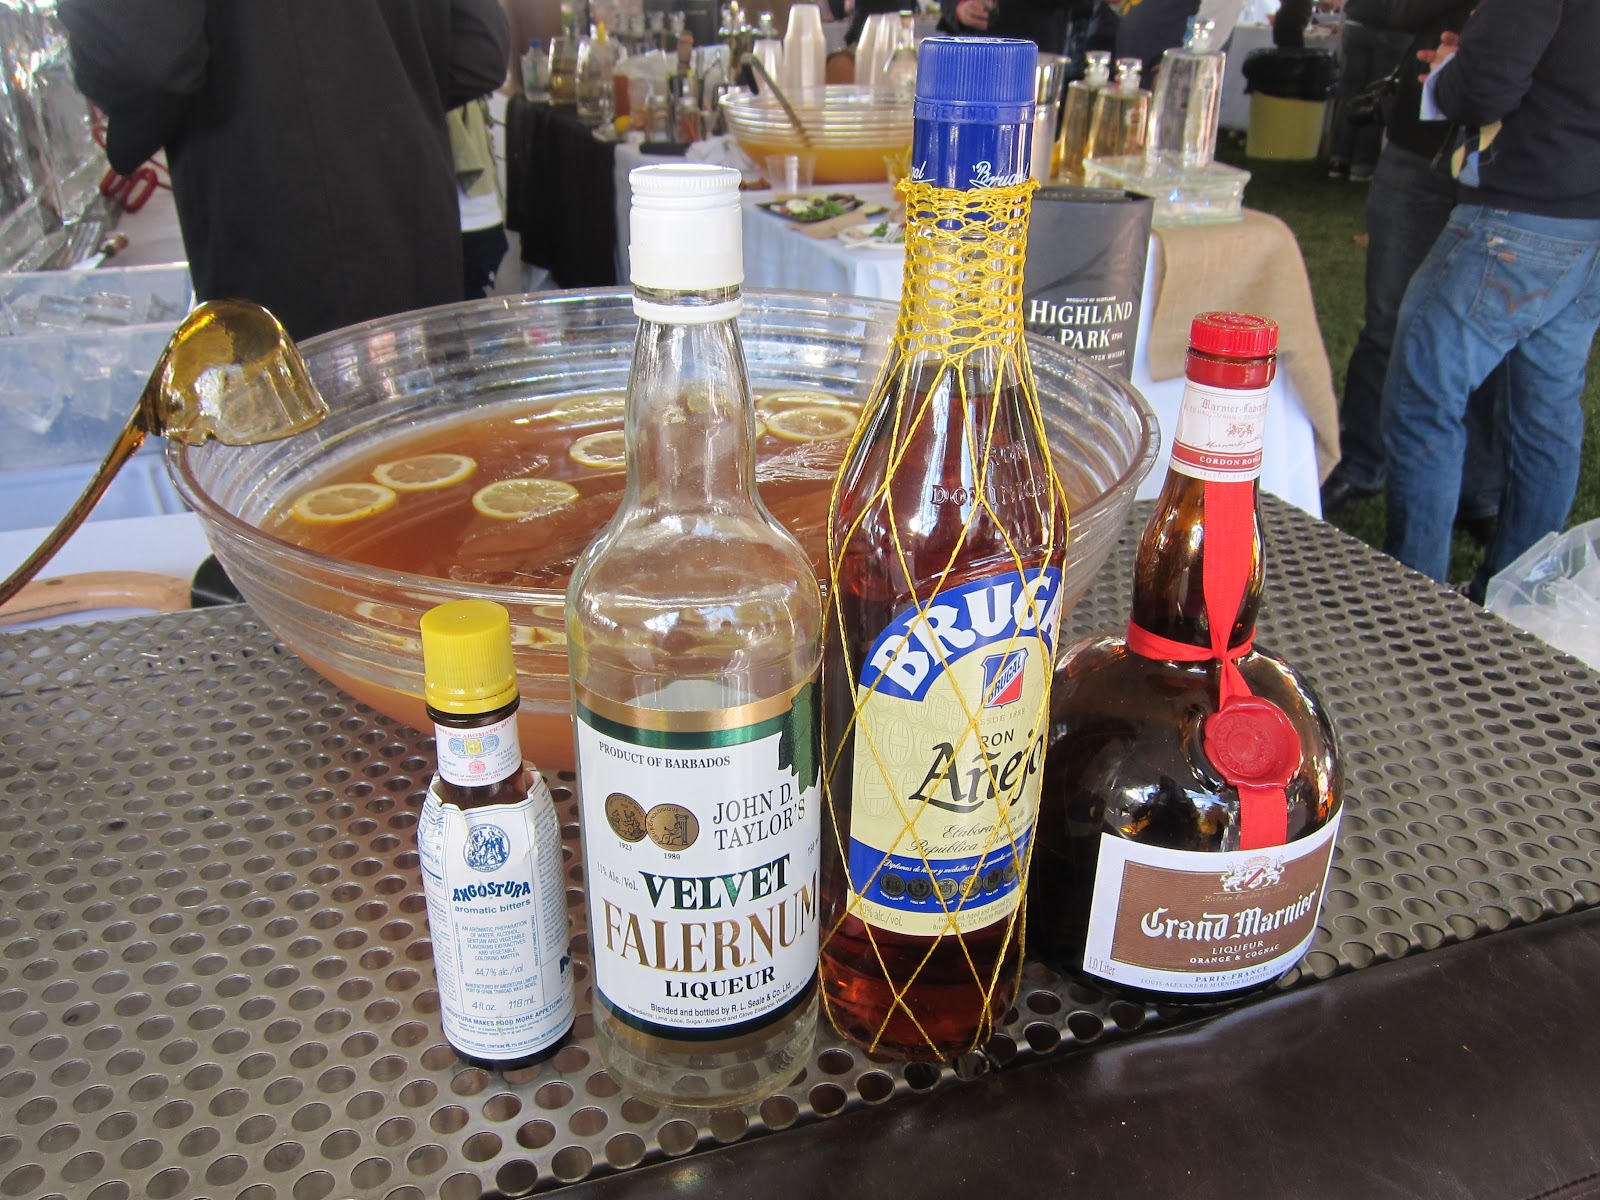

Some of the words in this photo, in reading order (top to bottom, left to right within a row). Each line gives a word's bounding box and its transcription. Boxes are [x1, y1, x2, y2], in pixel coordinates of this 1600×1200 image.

[1029, 299, 1133, 325] HIGHLAND
[1060, 328, 1111, 350] PARK
[1199, 455, 1240, 466] CORDON
[980, 728, 1015, 749] RON
[599, 740, 645, 766] PRODUCT
[646, 757, 662, 769] OF
[664, 755, 731, 769] BARBADOS
[712, 789, 774, 825] JOHN
[780, 782, 793, 804] D.
[714, 798, 806, 851] TAYLOR'S
[943, 820, 1004, 839] Elabora
[618, 841, 633, 852] 1923
[906, 838, 979, 857] República
[663, 852, 681, 861] 1980
[638, 853, 790, 910] VELVET
[452, 880, 531, 902] ANGOSTURA
[454, 904, 497, 914] aromatic
[499, 899, 531, 912] bitters
[601, 869, 818, 974] FALERNUM
[1141, 907, 1229, 942] Grand
[1230, 889, 1317, 939] Marnier
[494, 920, 528, 932] PREPARATION
[494, 939, 526, 949] EXTRACTIVES
[499, 933, 525, 943] VEGETABLE
[490, 947, 516, 956] VEGETABLE
[1189, 955, 1231, 964] ORANGE
[1244, 943, 1280, 959] COGNAC
[1212, 940, 1265, 955] LIQUEUR
[474, 968, 497, 977] 44.7%
[1099, 959, 1116, 976] Liter
[1195, 965, 1268, 982] PARIS-FRANCE
[665, 966, 776, 1001] LIQUEUR
[1140, 978, 1208, 989] LOUIS-ALEXANDRE
[1209, 980, 1240, 988] MARNIER
[508, 998, 523, 1009] 118
[651, 1003, 678, 1016] Blended
[679, 1007, 693, 1017] and
[694, 1007, 720, 1017] bottled
[721, 1006, 730, 1016] by
[731, 1004, 739, 1012] R.
[740, 1002, 747, 1011] L.
[747, 997, 765, 1009] Seale
[766, 993, 771, 1001] &
[772, 989, 781, 998] Co.
[473, 1019, 495, 1027] MAKES
[515, 1014, 534, 1024] MORE
[655, 1014, 668, 1022] Lime
[685, 1018, 704, 1026] Sugar,
[738, 1010, 754, 1019] Clove
